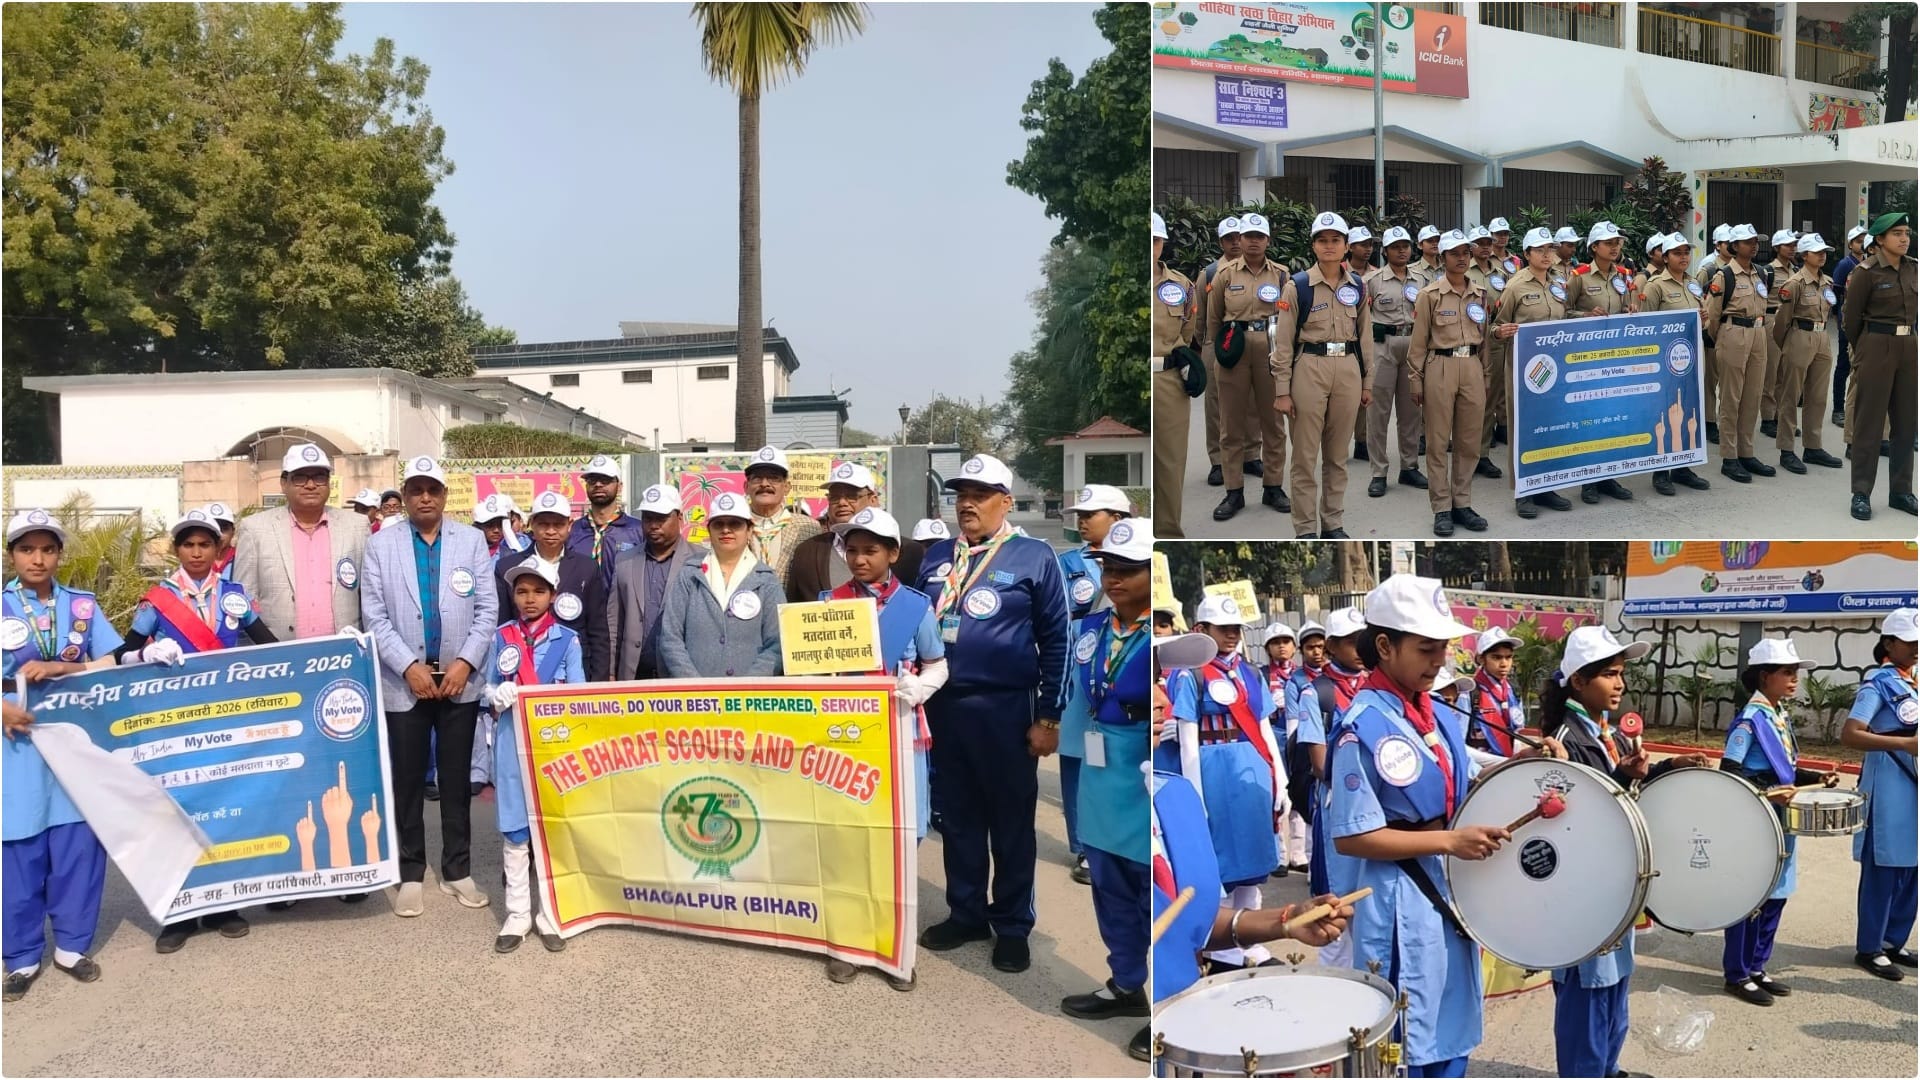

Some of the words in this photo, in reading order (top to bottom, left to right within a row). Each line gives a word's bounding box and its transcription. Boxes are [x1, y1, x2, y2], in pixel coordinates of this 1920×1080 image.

[1240, 6, 1264, 20] स्वच्छ
[1267, 7, 1292, 24] बिहार
[1297, 13, 1335, 30] अभियान
[1418, 51, 1442, 64] ICICI
[1443, 54, 1464, 67] Bank
[1218, 81, 1239, 95] सात
[1241, 80, 1284, 100] निश्चय-3
[1536, 330, 1574, 347] राष्ट्रीय
[1576, 328, 1620, 342] मतदाता
[1624, 324, 1658, 338] दिवस,
[1662, 322, 1686, 334] 2026
[802, 608, 855, 623] शत-प्रतिशत
[802, 630, 836, 642] मतदाता
[792, 650, 822, 664] भागलपुर
[824, 646, 834, 660] की
[45, 684, 123, 710] राष्ट्रीय
[129, 670, 218, 698] मतदाता
[225, 661, 296, 684] दिवस,
[304, 654, 352, 675] 2026
[160, 712, 173, 724] 25
[176, 706, 211, 720] जनवरी
[216, 702, 242, 714] 2026
[246, 696, 288, 711] (रविवार)
[325, 708, 340, 718] My
[340, 706, 362, 715] Vote
[534, 703, 566, 717] KEEP
[570, 701, 624, 716] SMILING,
[628, 700, 645, 713] DO
[648, 699, 682, 712] YOUR
[686, 698, 722, 714] BEST,
[726, 698, 742, 712] BE
[746, 698, 818, 715] PREPARED,
[821, 698, 880, 713] SERVICE
[184, 736, 204, 749] My
[205, 732, 232, 745] Vote
[210, 766, 228, 778] कोई
[230, 762, 264, 774] मतदाता
[542, 754, 586, 795] THE
[585, 731, 661, 782] BHARAT
[665, 728, 746, 763] SCOUTS
[750, 732, 795, 772] AND
[800, 744, 881, 804] GUIDES
[233, 882, 262, 897] जिला
[267, 872, 326, 892] पदाधिकारी,
[330, 868, 379, 885] भागलपुर
[622, 886, 738, 912] BHAGALPUR
[743, 896, 818, 924] (BIHAR)
